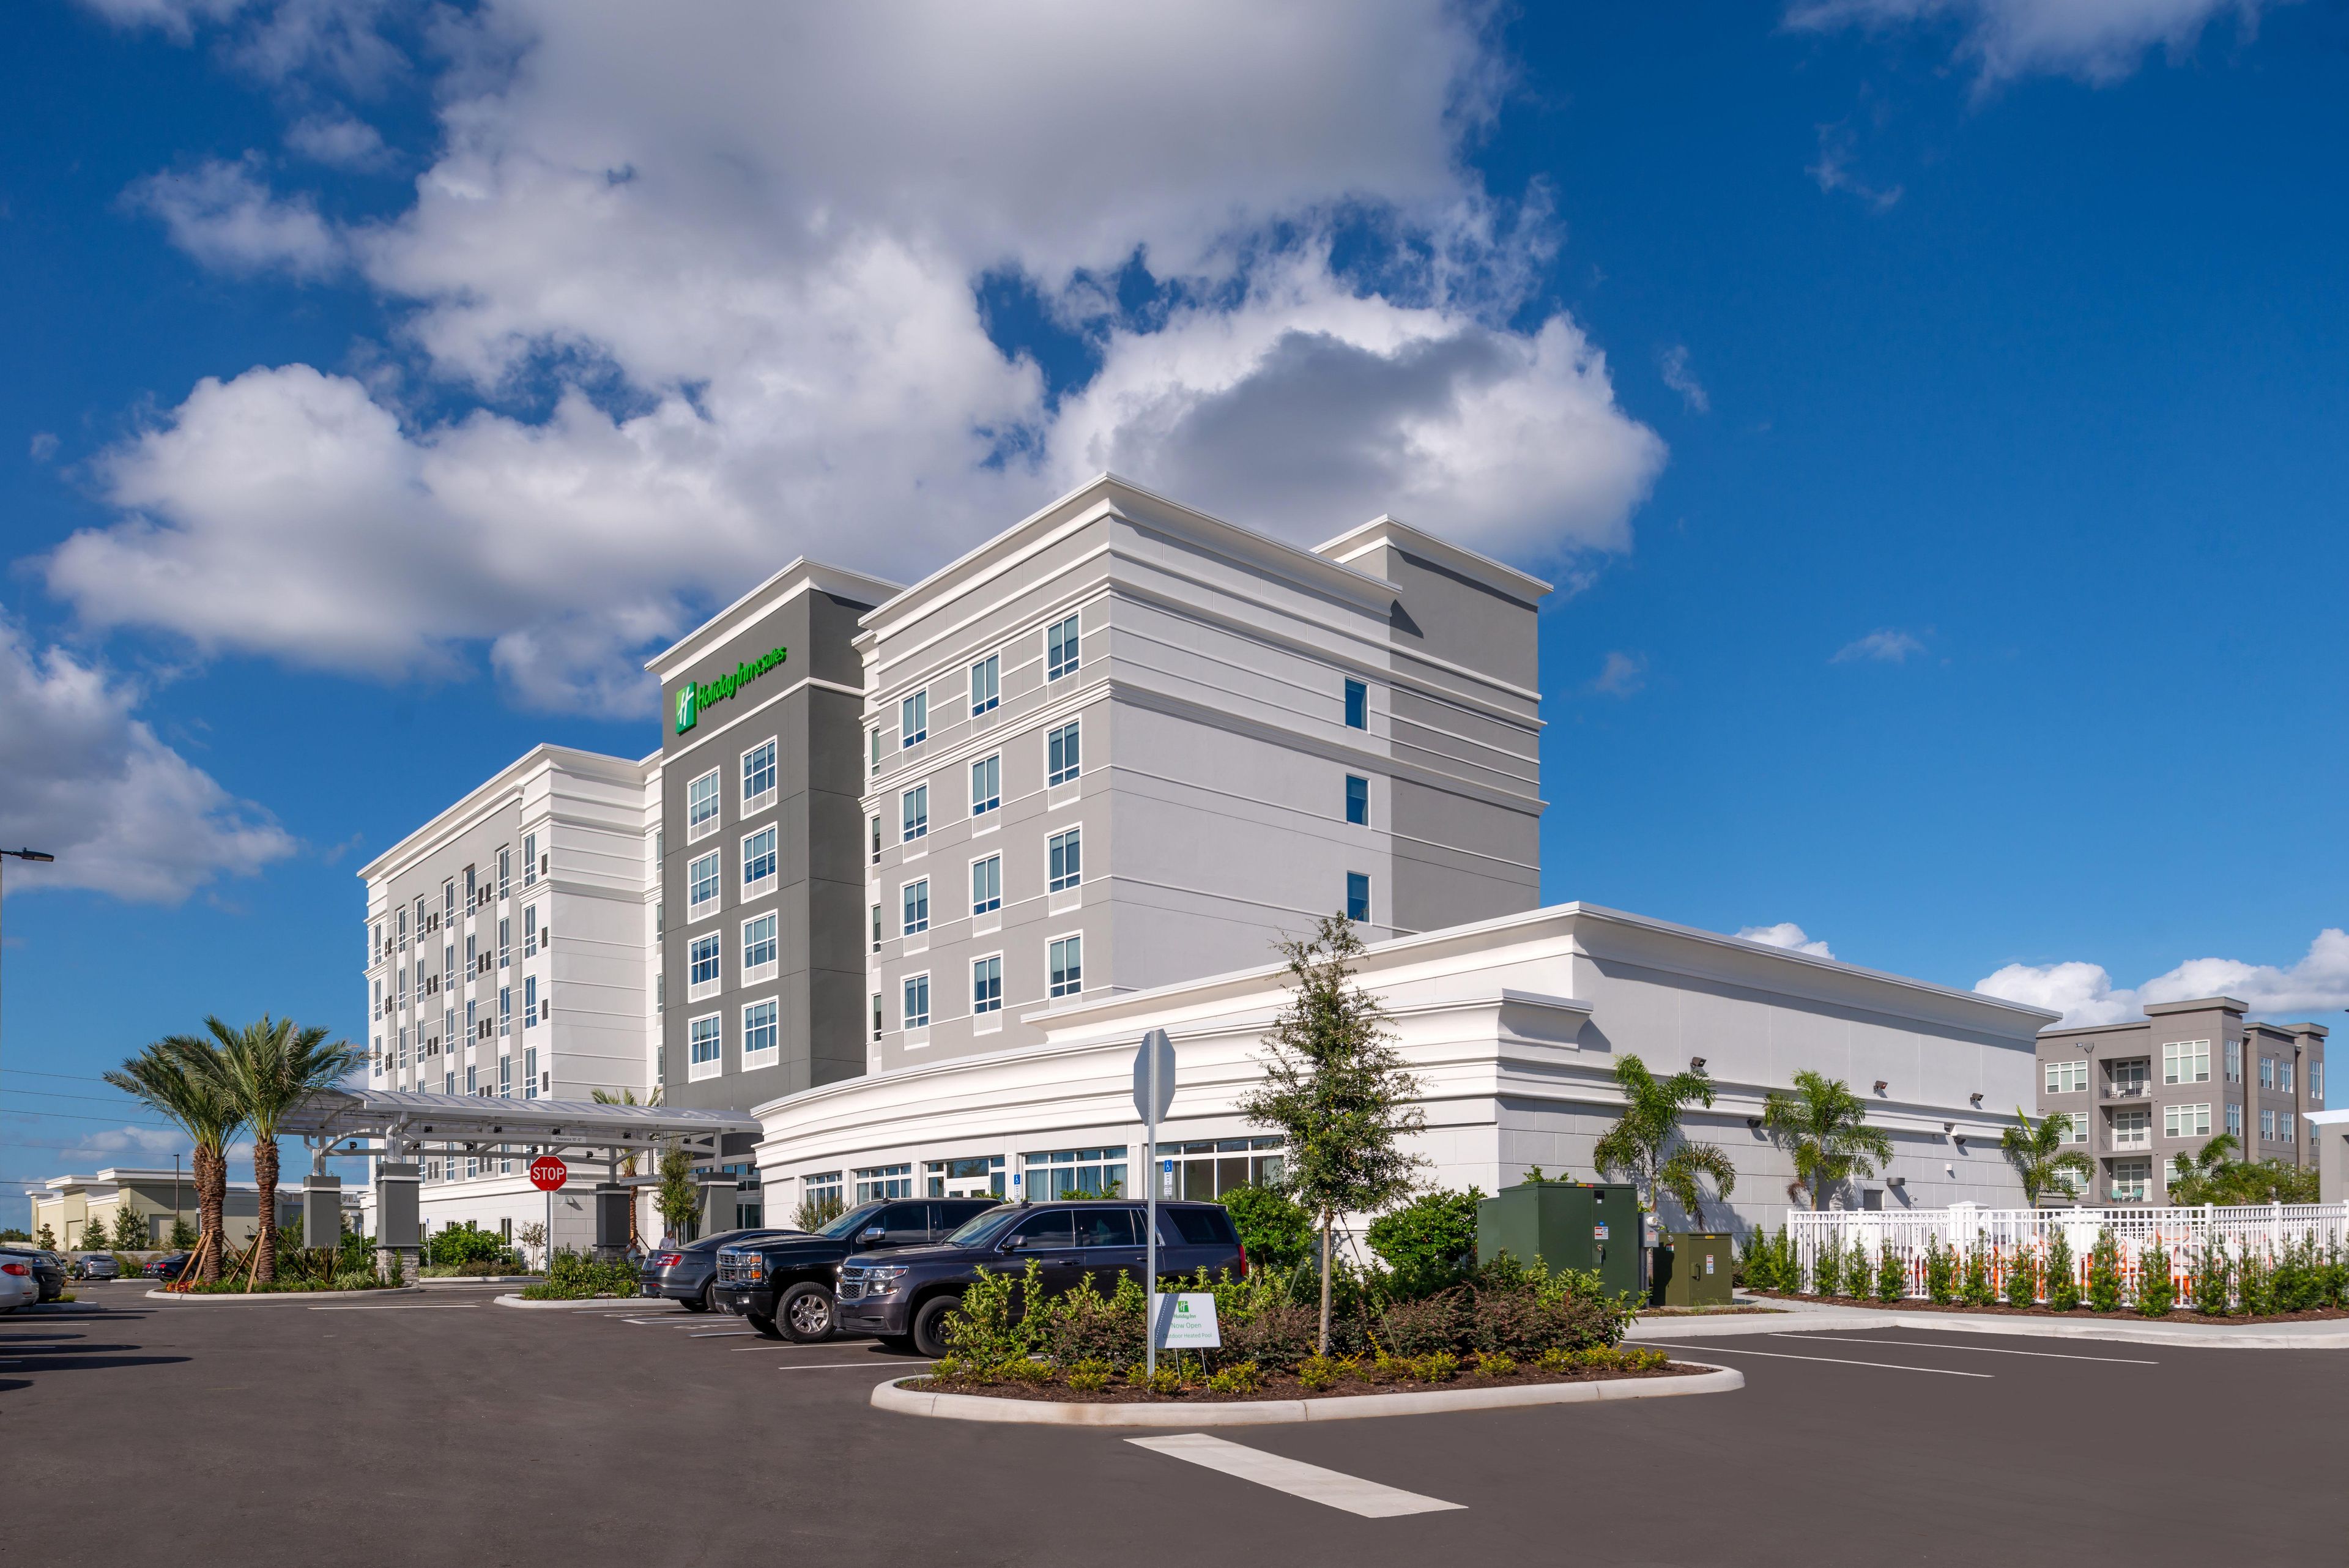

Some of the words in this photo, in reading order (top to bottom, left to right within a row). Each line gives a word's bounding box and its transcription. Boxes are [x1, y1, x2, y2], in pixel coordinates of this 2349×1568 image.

[697, 674, 738, 710] Holiday
[737, 662, 756, 686] Inn
[755, 660, 762, 674] &
[762, 647, 787, 671] Suites
[532, 1167, 565, 1181] STOP
